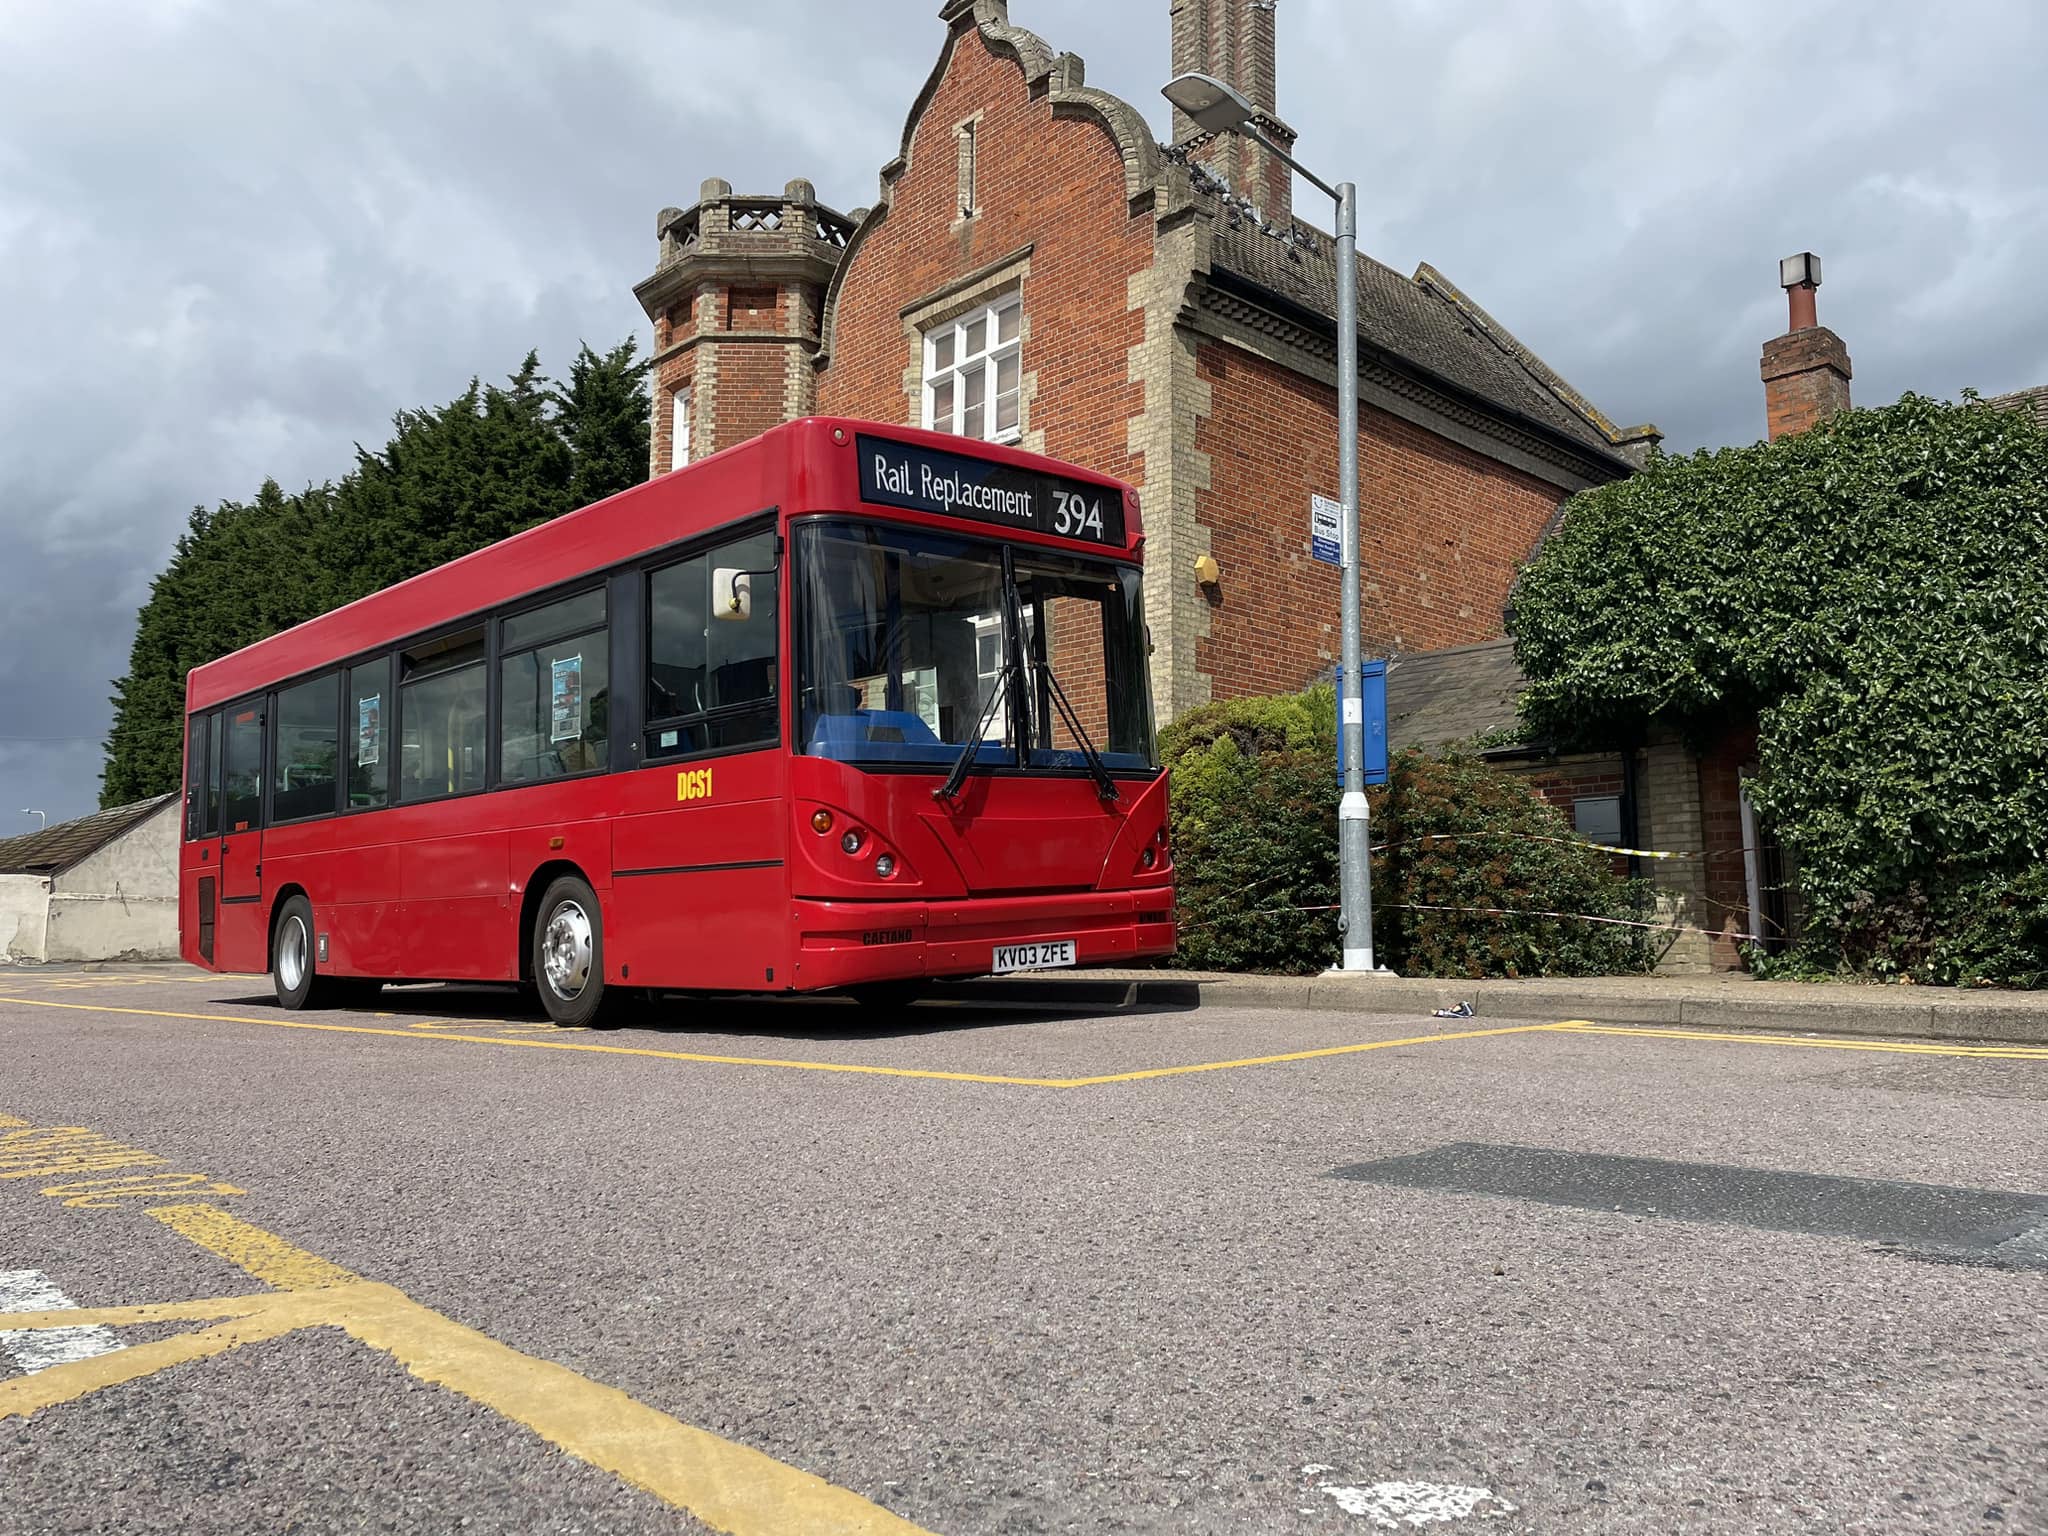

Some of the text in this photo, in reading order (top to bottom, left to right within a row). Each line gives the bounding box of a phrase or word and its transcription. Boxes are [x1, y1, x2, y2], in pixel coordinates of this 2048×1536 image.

[875, 454, 1104, 540] Rail Replacement 394
[677, 767, 713, 802] DCS1
[998, 943, 1070, 969] KV03 ZFE
